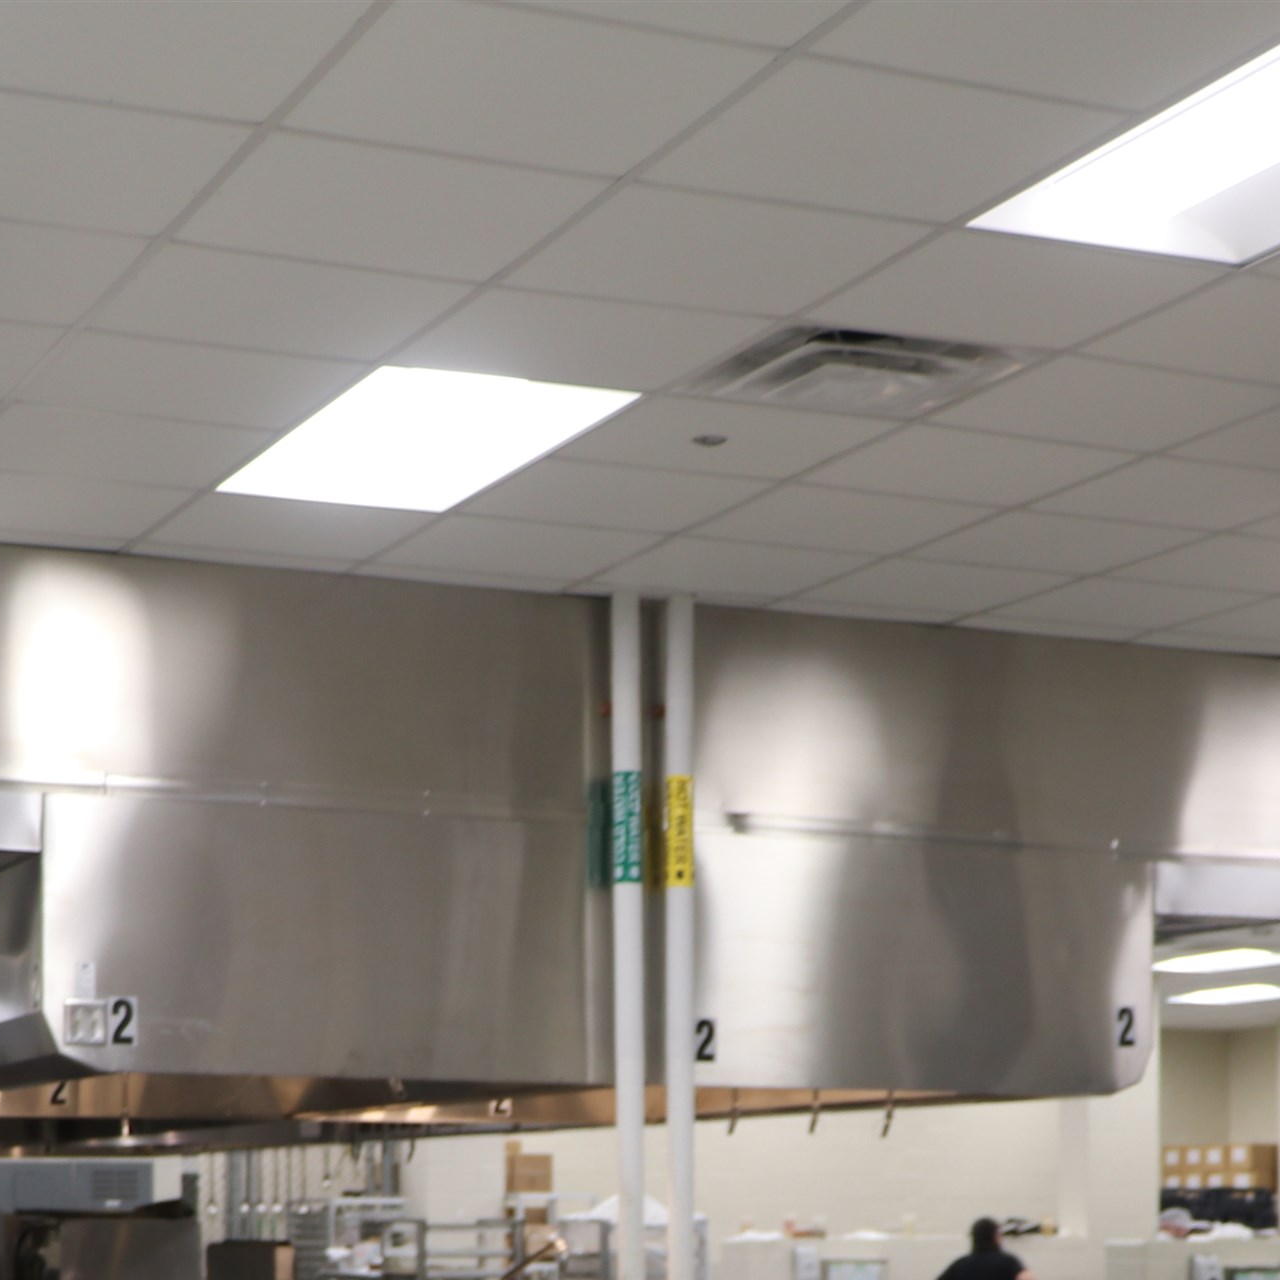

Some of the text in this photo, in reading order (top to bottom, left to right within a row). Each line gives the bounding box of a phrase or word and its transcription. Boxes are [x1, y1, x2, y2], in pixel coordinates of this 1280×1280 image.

[111, 998, 134, 1044] 2
[694, 1018, 715, 1062] 2
[1117, 1006, 1135, 1047] 2
